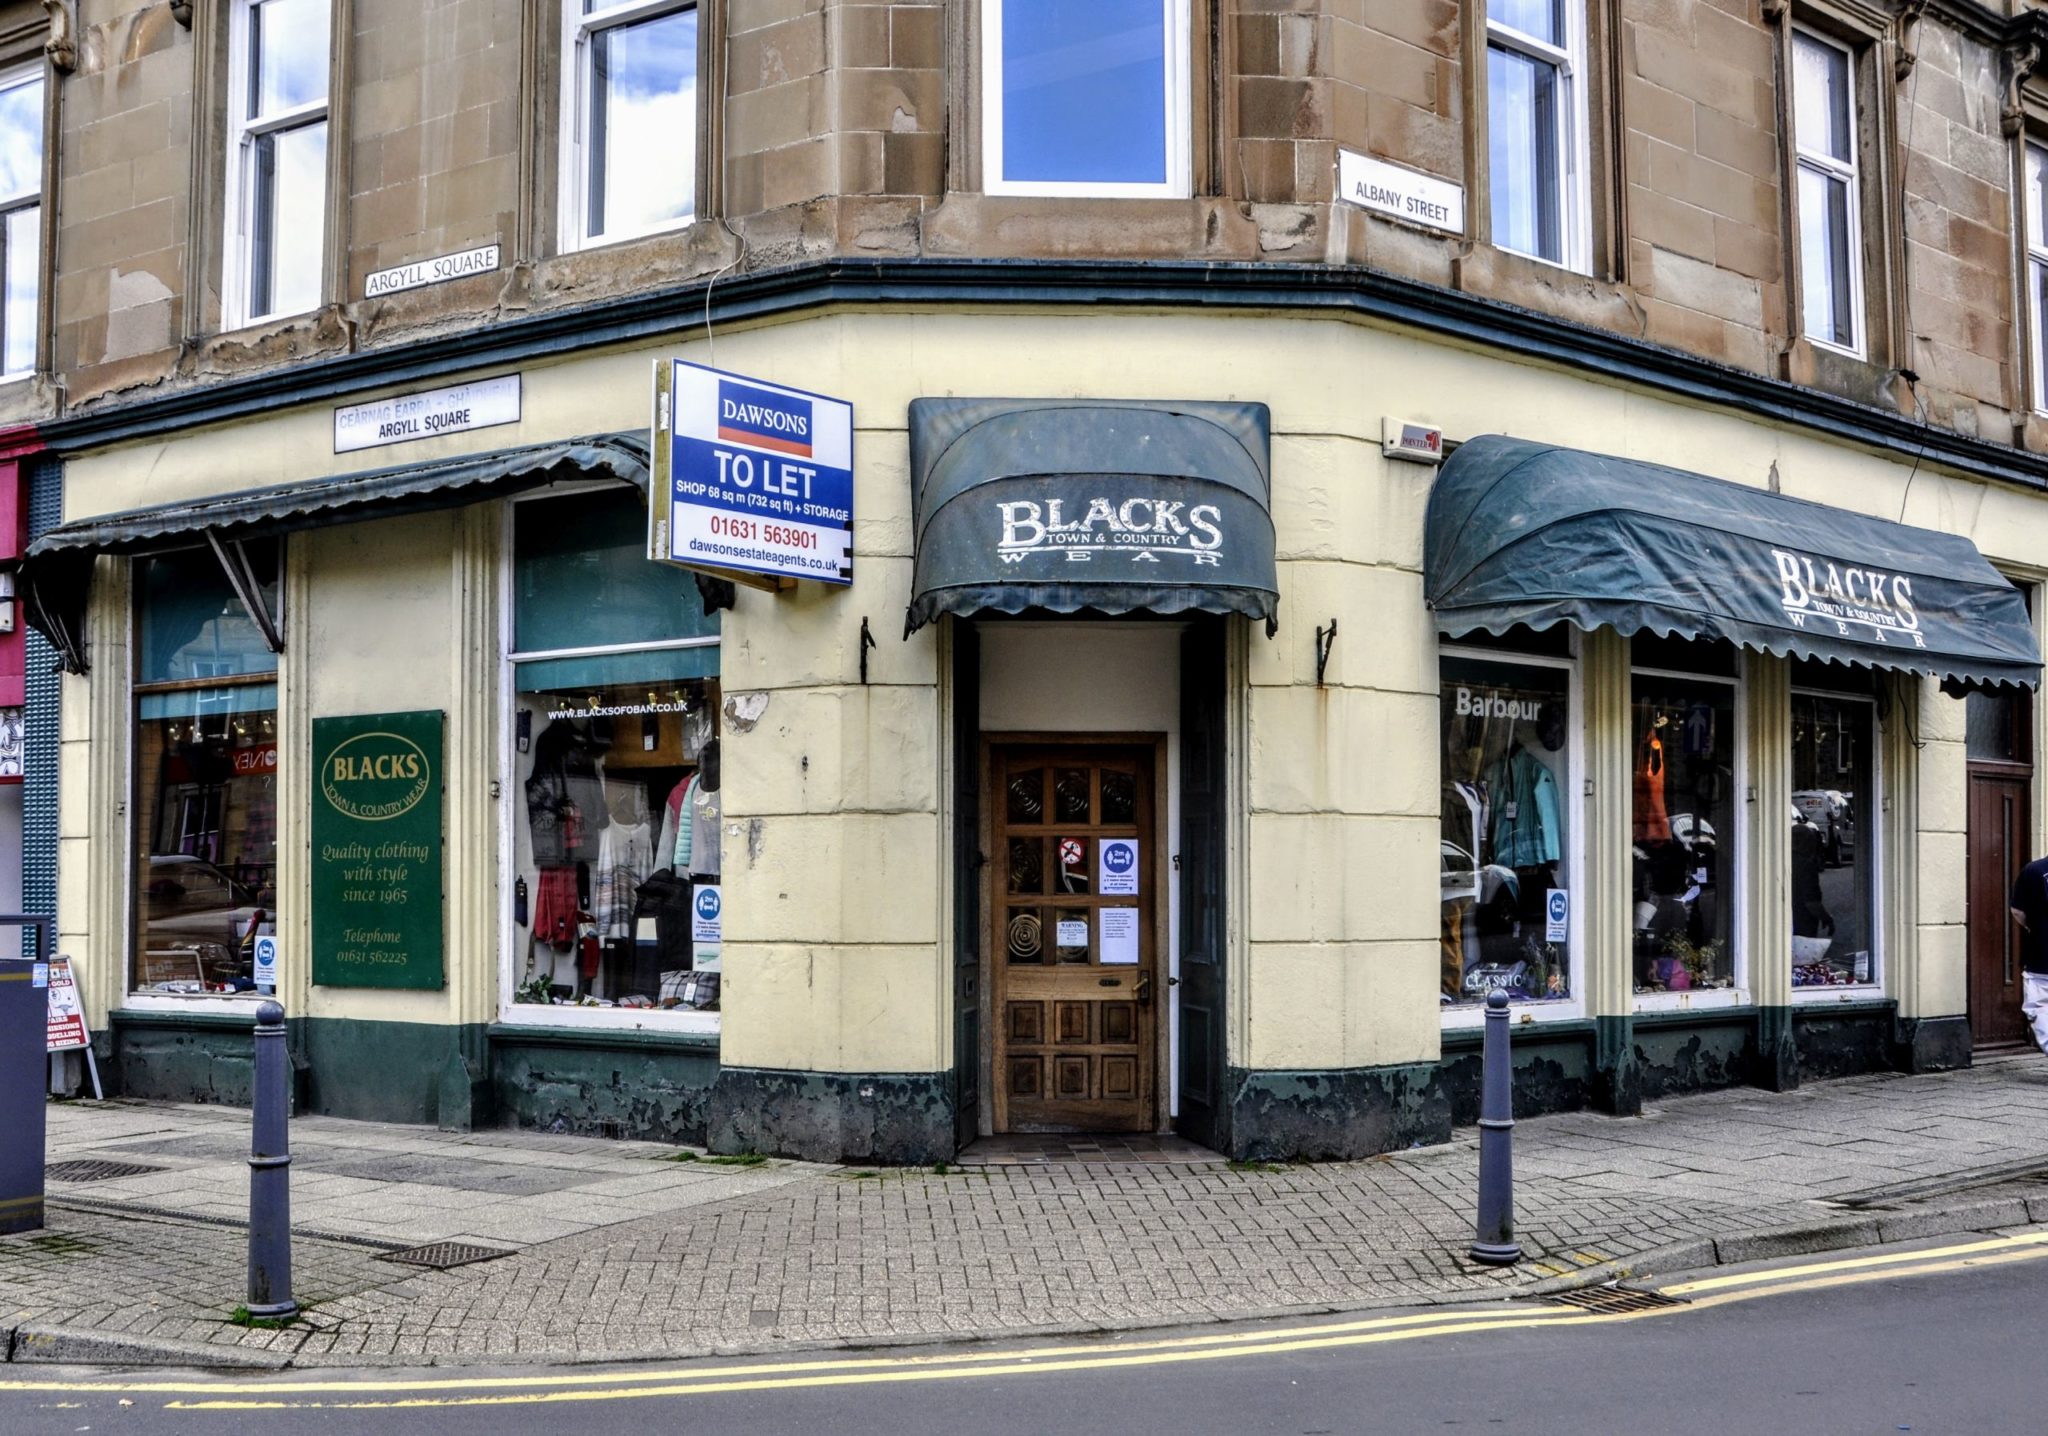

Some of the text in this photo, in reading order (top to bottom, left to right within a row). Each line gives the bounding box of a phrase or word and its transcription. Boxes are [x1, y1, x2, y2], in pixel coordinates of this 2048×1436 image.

[1356, 181, 1449, 222] ALBANY STREET
[369, 249, 494, 293] ARGYLL SQUARE
[379, 409, 470, 439] ARGYLL SQUARE
[723, 399, 807, 435] DAWSONS
[714, 450, 817, 499] TO LET
[676, 480, 849, 521] SHOP 68 sq m (732 sq ft) + STORAGE
[711, 515, 818, 550] 01631 563901
[996, 497, 1223, 551] BLACKS
[1047, 532, 1180, 546] TOWN & COUNTRY
[690, 537, 838, 572] dawsonsestateagents.co.uk
[1771, 549, 1919, 630] BLACKS
[1813, 600, 1897, 627] TOWN & COUNTRY
[1456, 686, 1542, 721] Barbour
[334, 753, 420, 781] BLACKS
[326, 778, 427, 816] TOWN & COUNTRY WEAR
[322, 840, 429, 864] Quality clothing
[343, 863, 408, 886] with style
[342, 886, 408, 904] since 1965
[343, 927, 401, 947] Telephone
[337, 950, 408, 965] 01631 562225
[1465, 974, 1523, 988] CLASSIC
